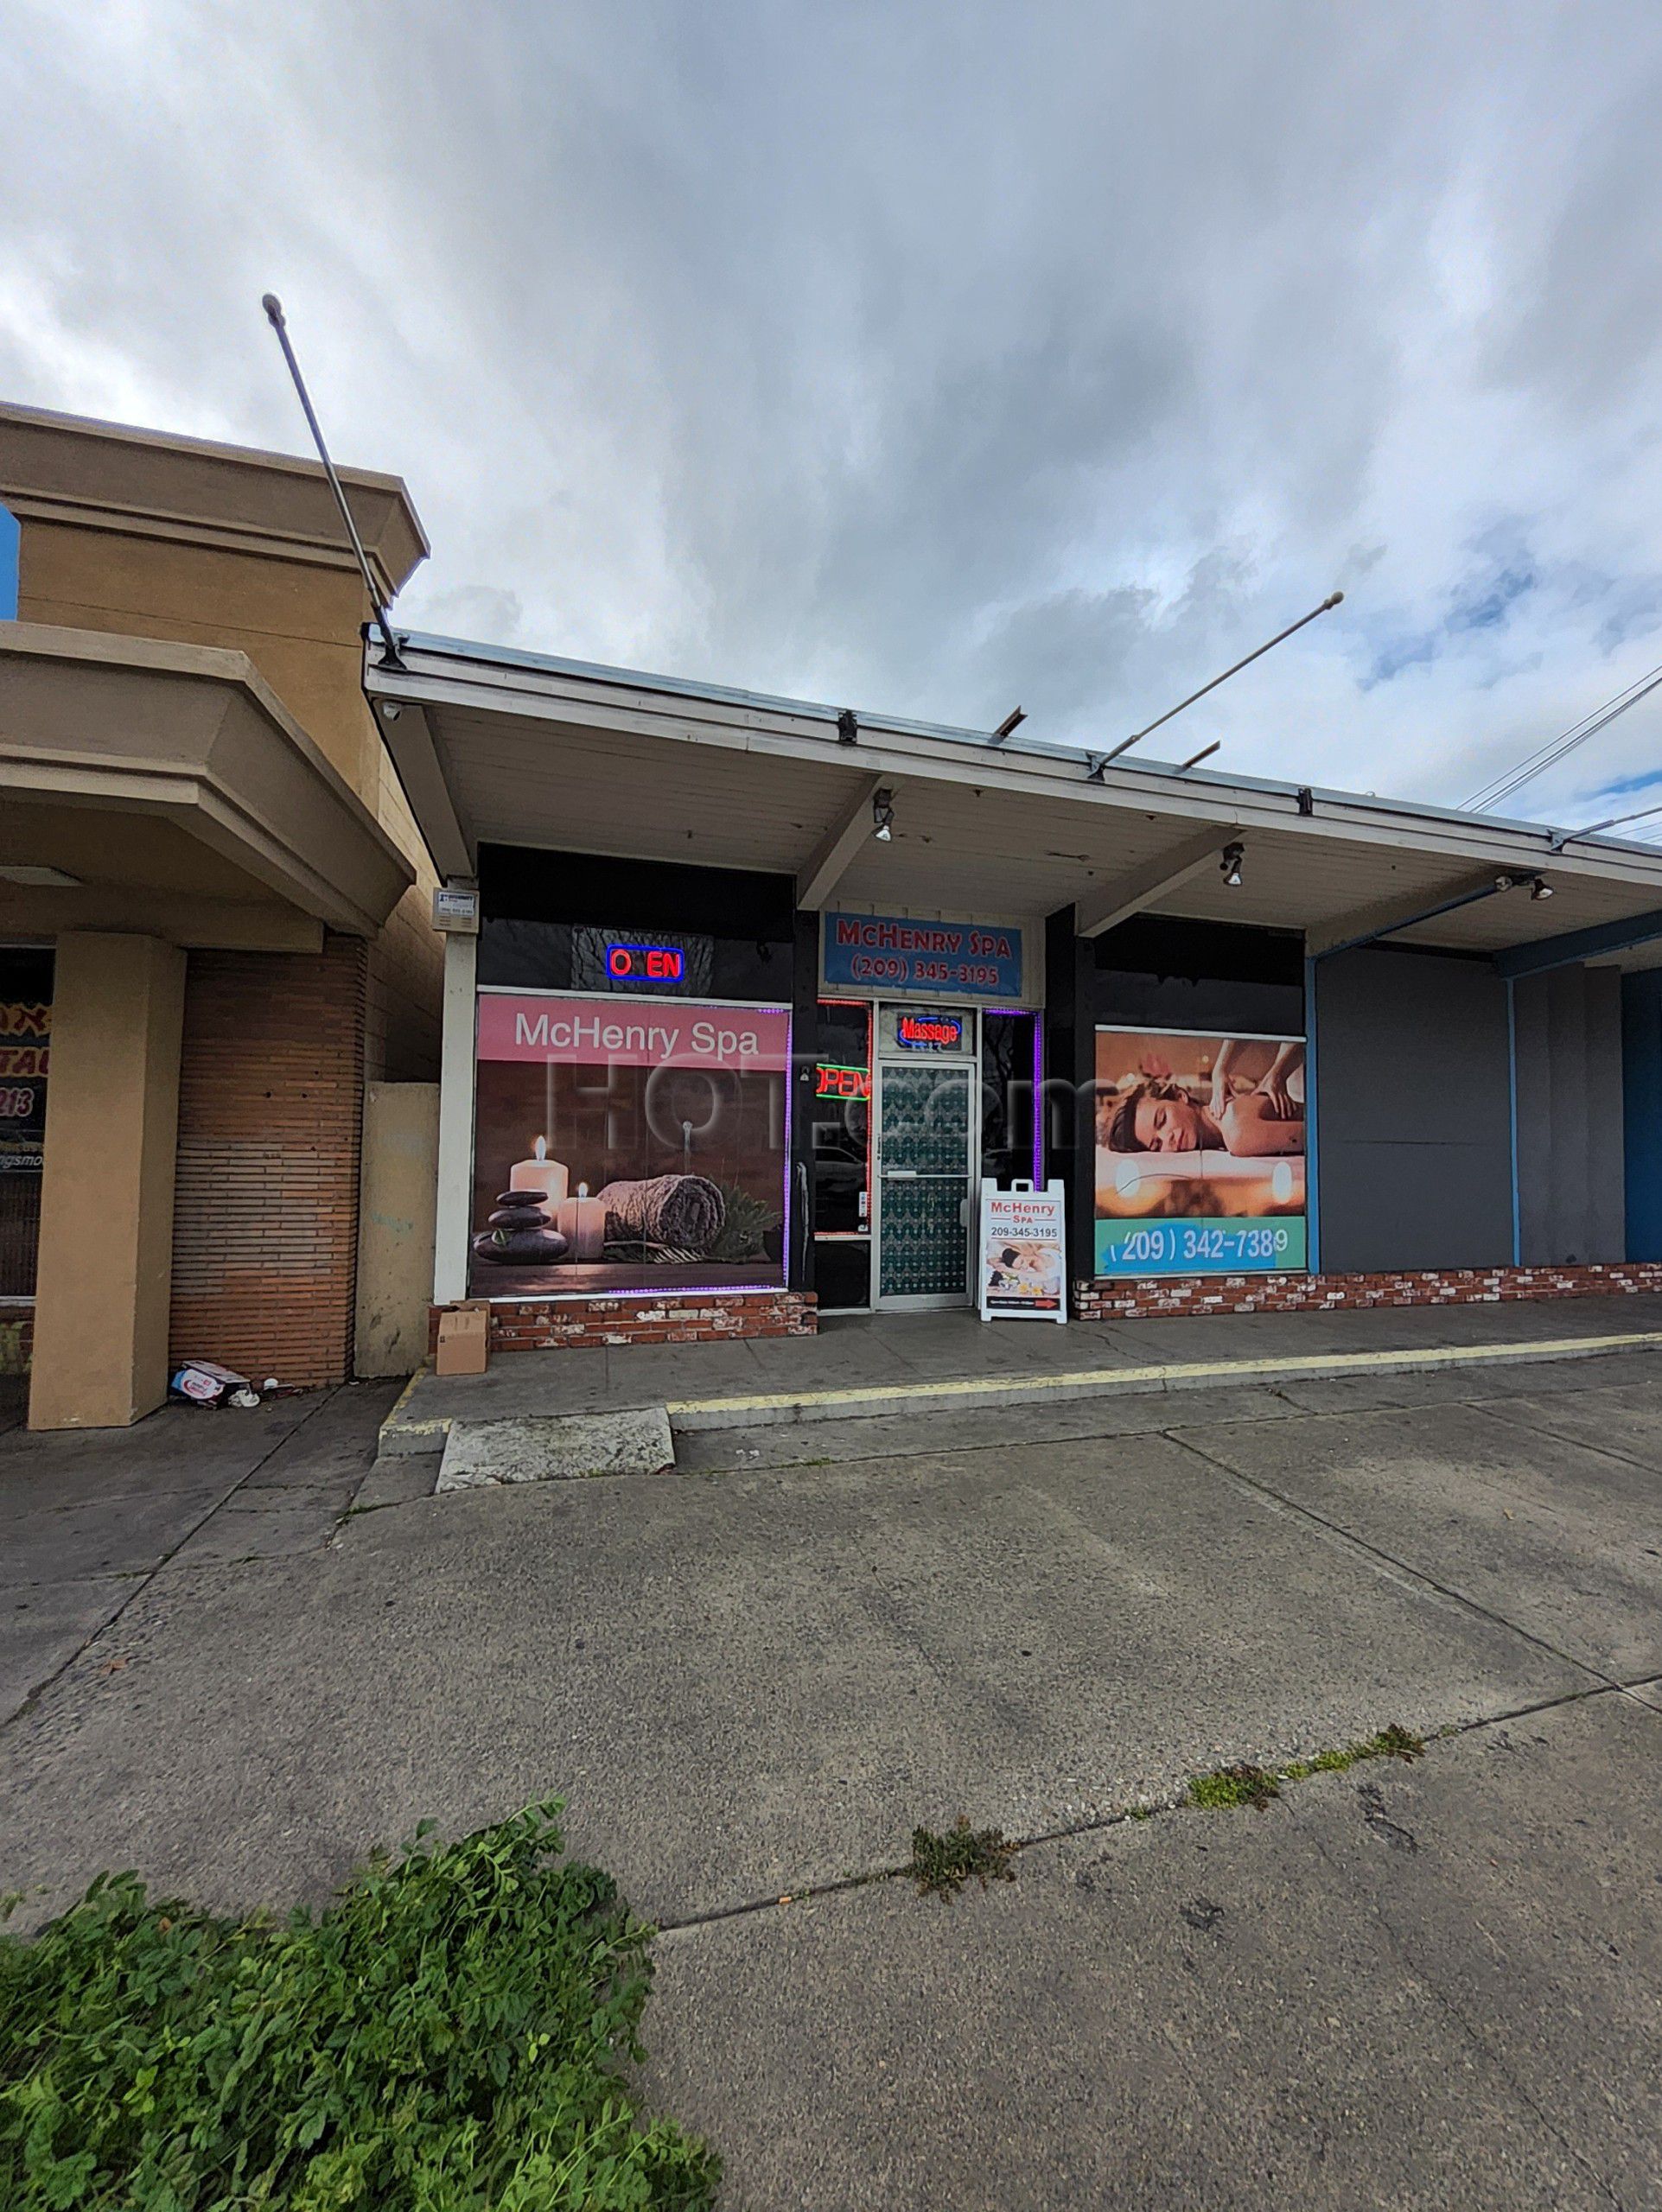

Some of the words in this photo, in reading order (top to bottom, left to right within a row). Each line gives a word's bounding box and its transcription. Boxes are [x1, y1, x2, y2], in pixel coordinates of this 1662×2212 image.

[610, 949, 680, 977] OEN
[850, 953, 908, 982] (209)
[914, 960, 999, 987] 345-3195
[515, 1013, 679, 1059] McHenry
[691, 1021, 759, 1061] Spa
[901, 1017, 958, 1045] Massage
[990, 1201, 1055, 1217] McHenry
[1013, 1214, 1034, 1224] SPA
[990, 1227, 1058, 1238] 209-345-3195
[1183, 1229, 1288, 1259] 342-7389
